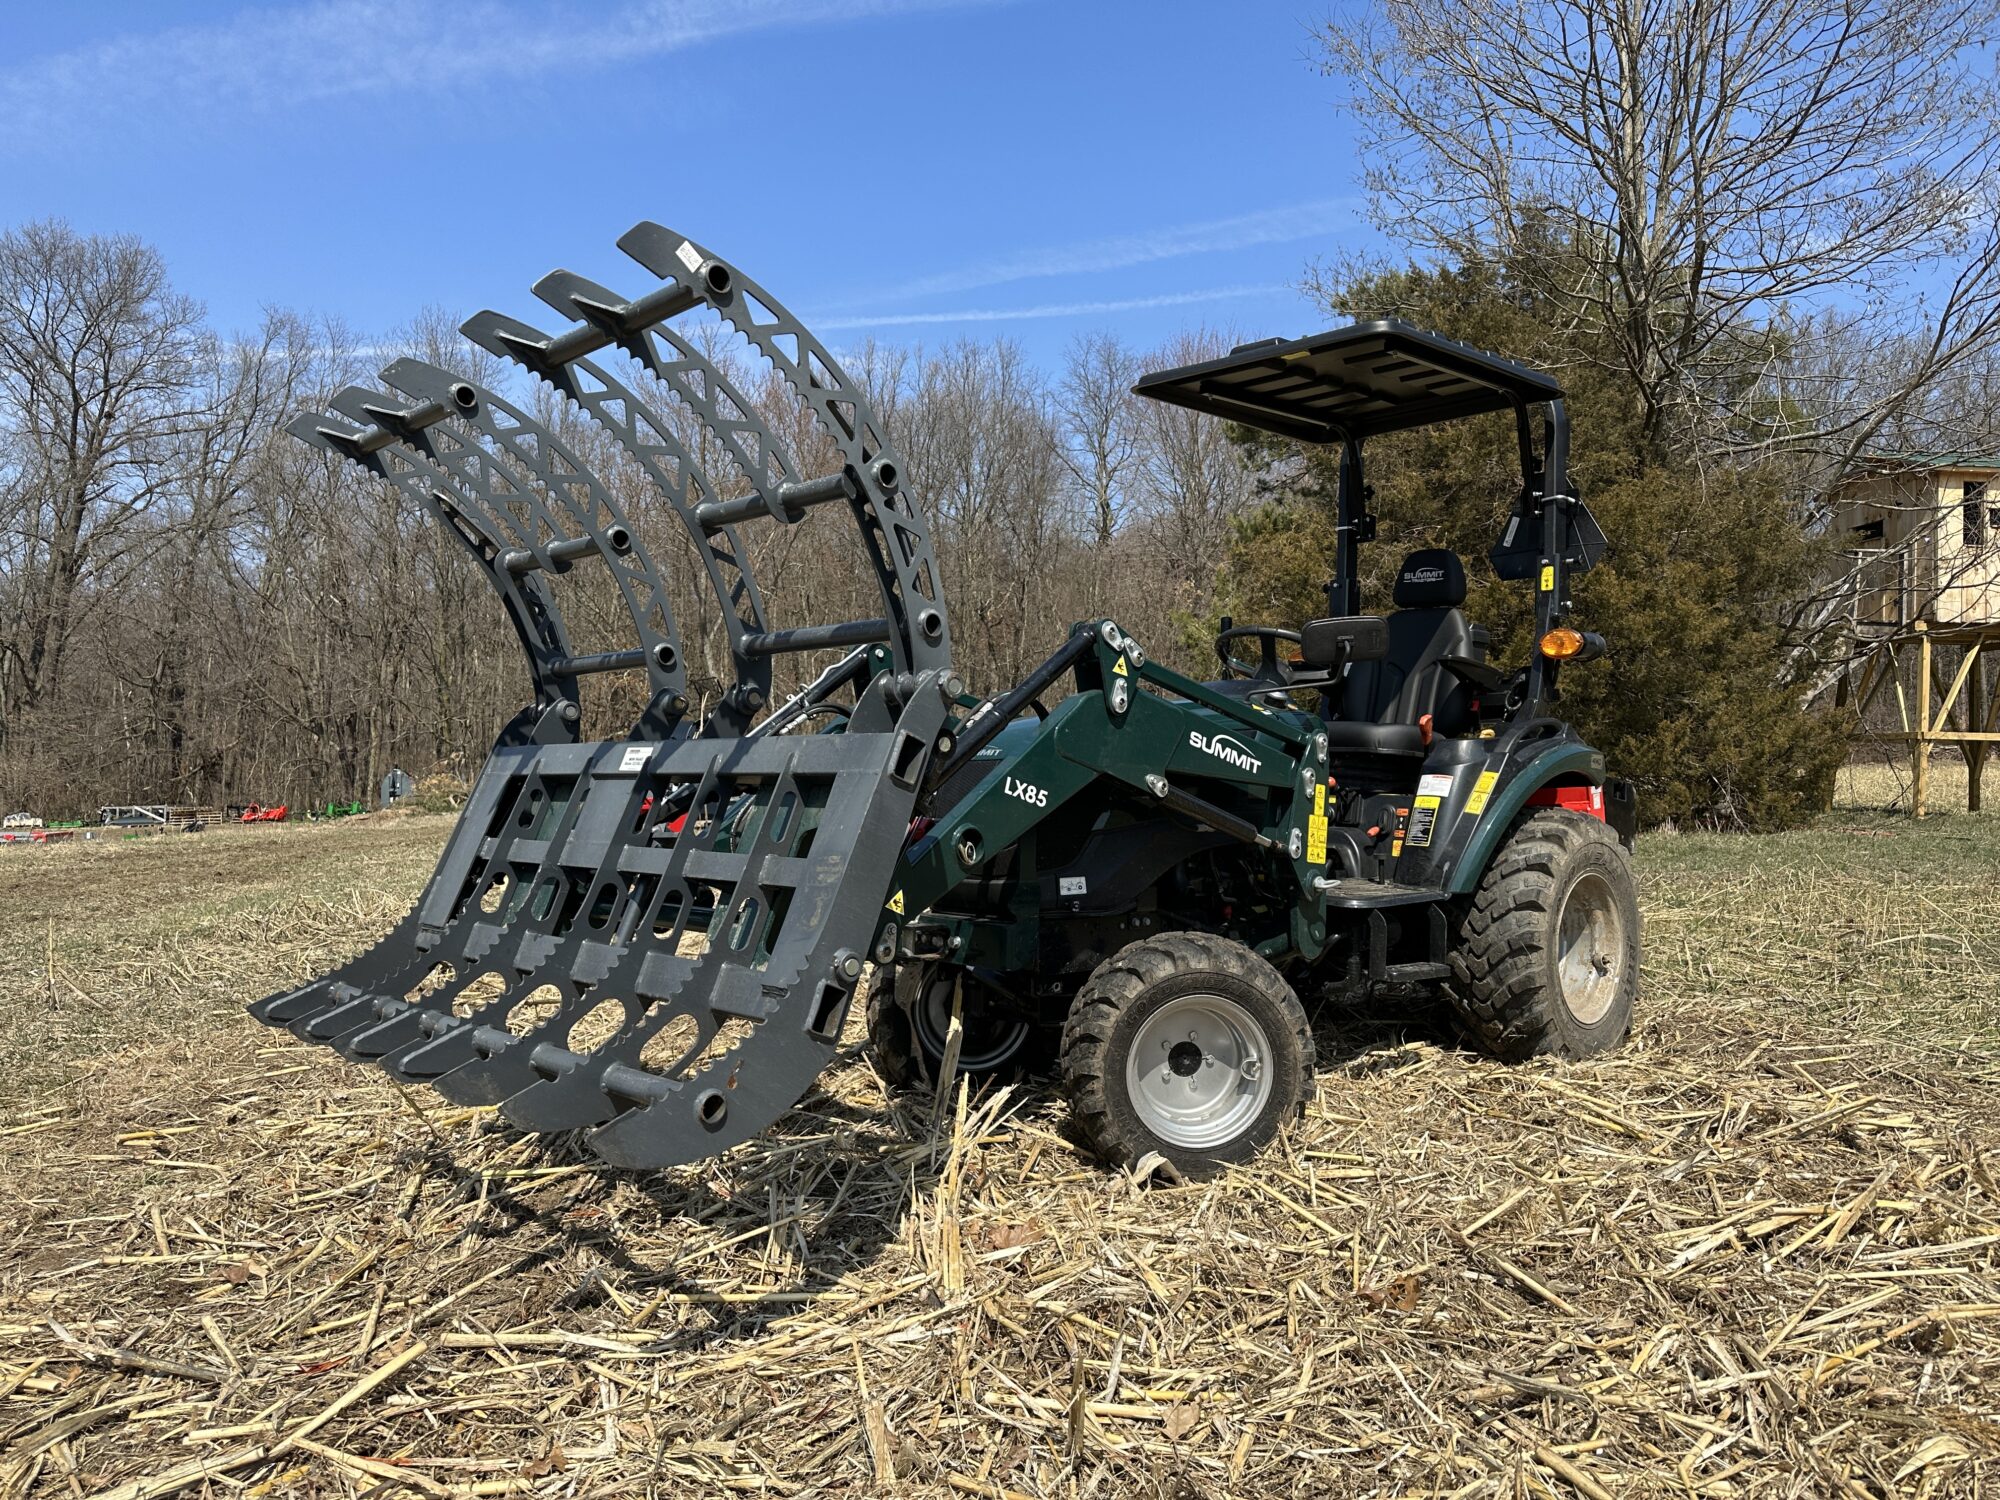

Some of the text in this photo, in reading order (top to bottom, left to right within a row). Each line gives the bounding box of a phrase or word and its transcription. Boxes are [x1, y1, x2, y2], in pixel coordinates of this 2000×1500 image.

[1404, 567, 1444, 579] SUMMIT
[1189, 731, 1262, 774] SUMMIT
[1004, 776, 1049, 808] LX85
